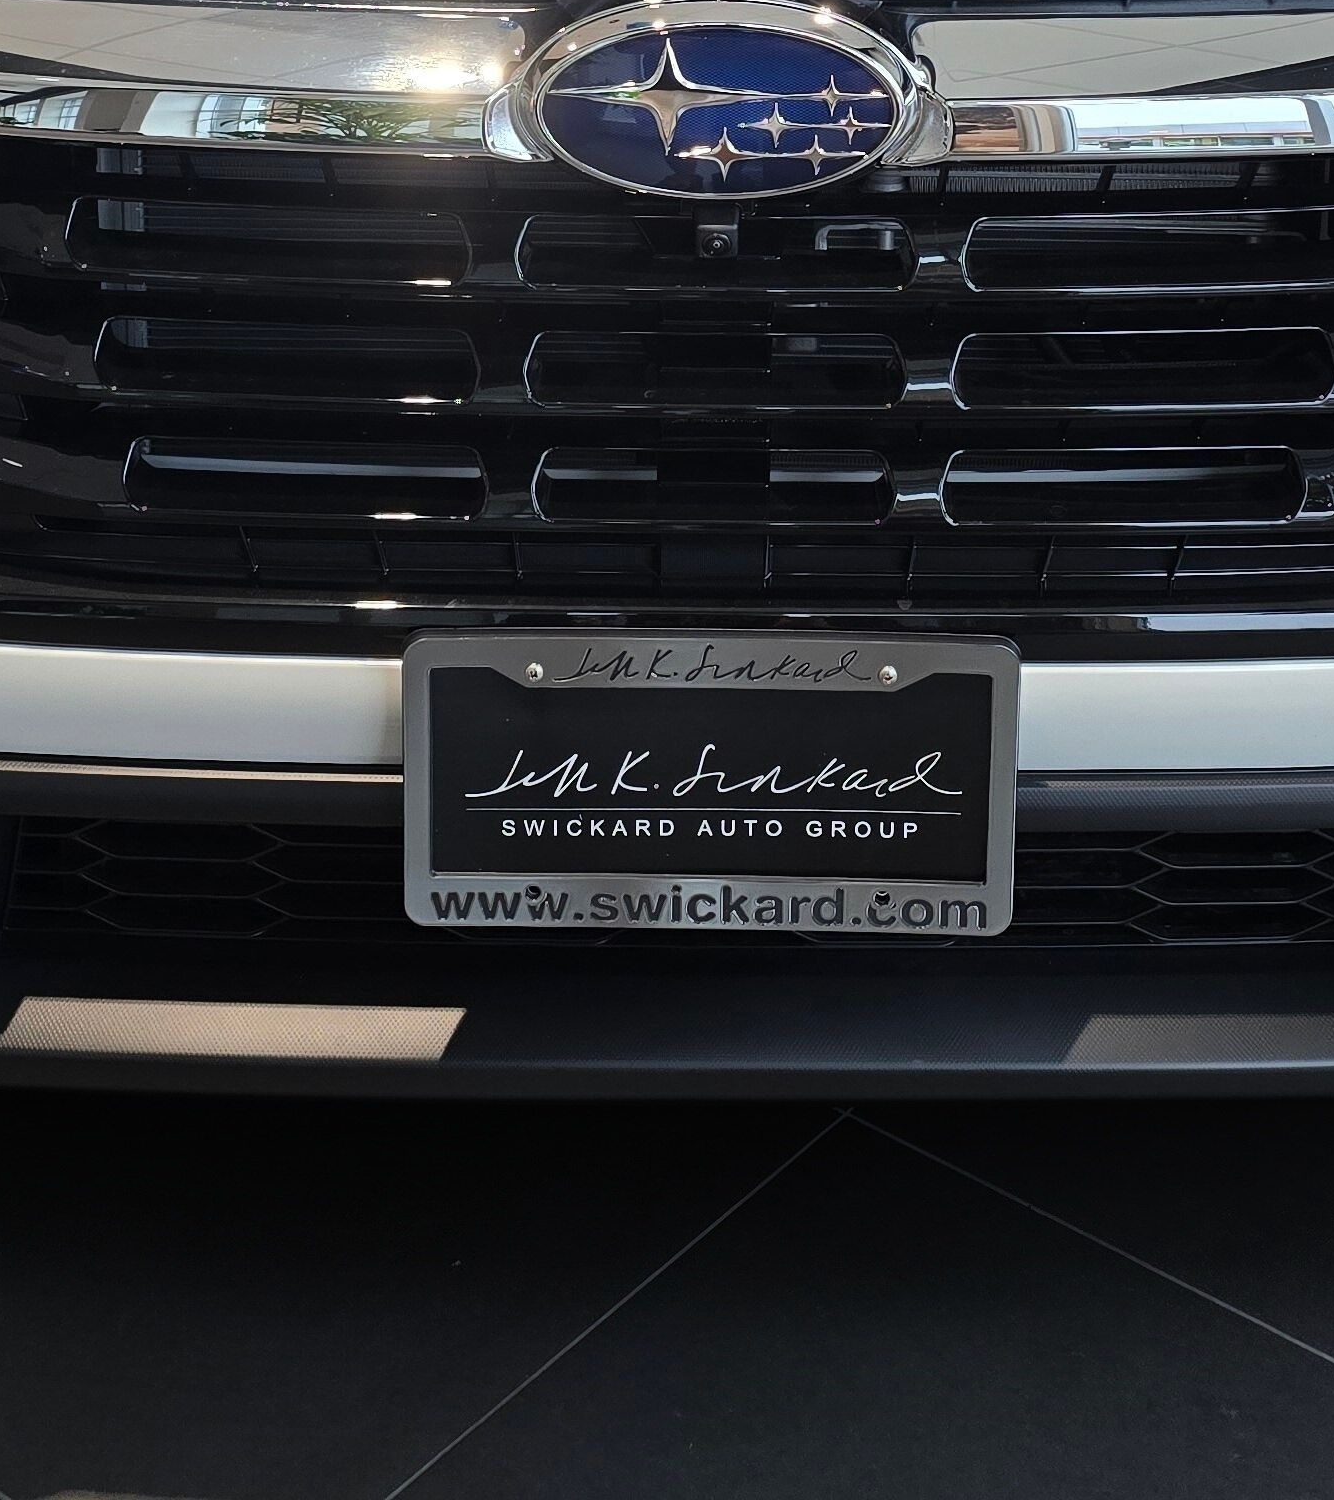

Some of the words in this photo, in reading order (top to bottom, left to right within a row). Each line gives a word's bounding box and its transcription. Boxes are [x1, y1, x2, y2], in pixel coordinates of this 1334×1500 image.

[501, 818, 676, 838] SWICKARD
[696, 818, 784, 838] AUTO
[805, 819, 919, 840] GROUP
[430, 884, 988, 931] www.swickard.com
